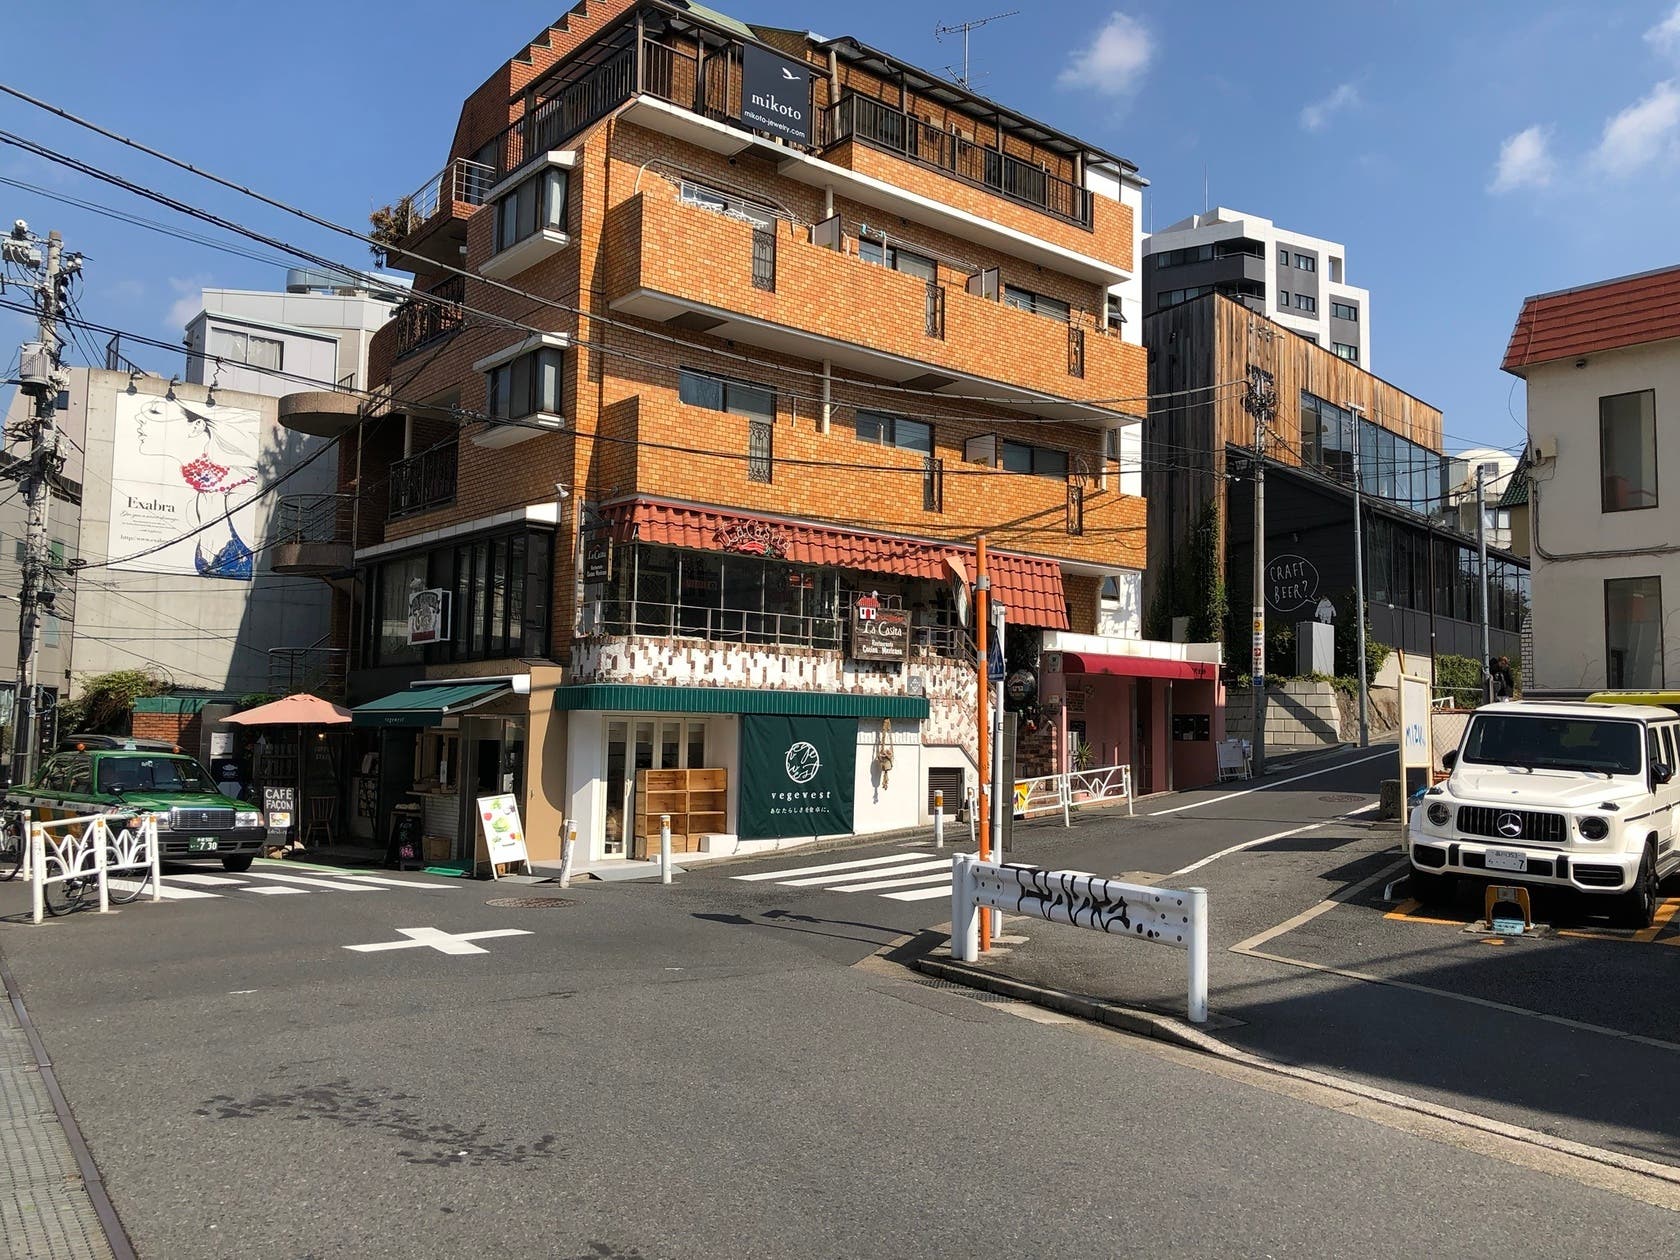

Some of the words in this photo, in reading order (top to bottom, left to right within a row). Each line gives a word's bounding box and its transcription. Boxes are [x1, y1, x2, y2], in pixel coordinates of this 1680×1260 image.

[752, 94, 801, 120] mikoto
[744, 111, 805, 138] mikoto-jewelry.com
[128, 496, 175, 512] Exabra
[1270, 561, 1305, 582] CRAFT
[1274, 580, 1308, 604] BEER?
[862, 620, 876, 634] La
[878, 621, 902, 637] Casita
[266, 799, 293, 811] FAÇON
[771, 791, 831, 802] vegevest
